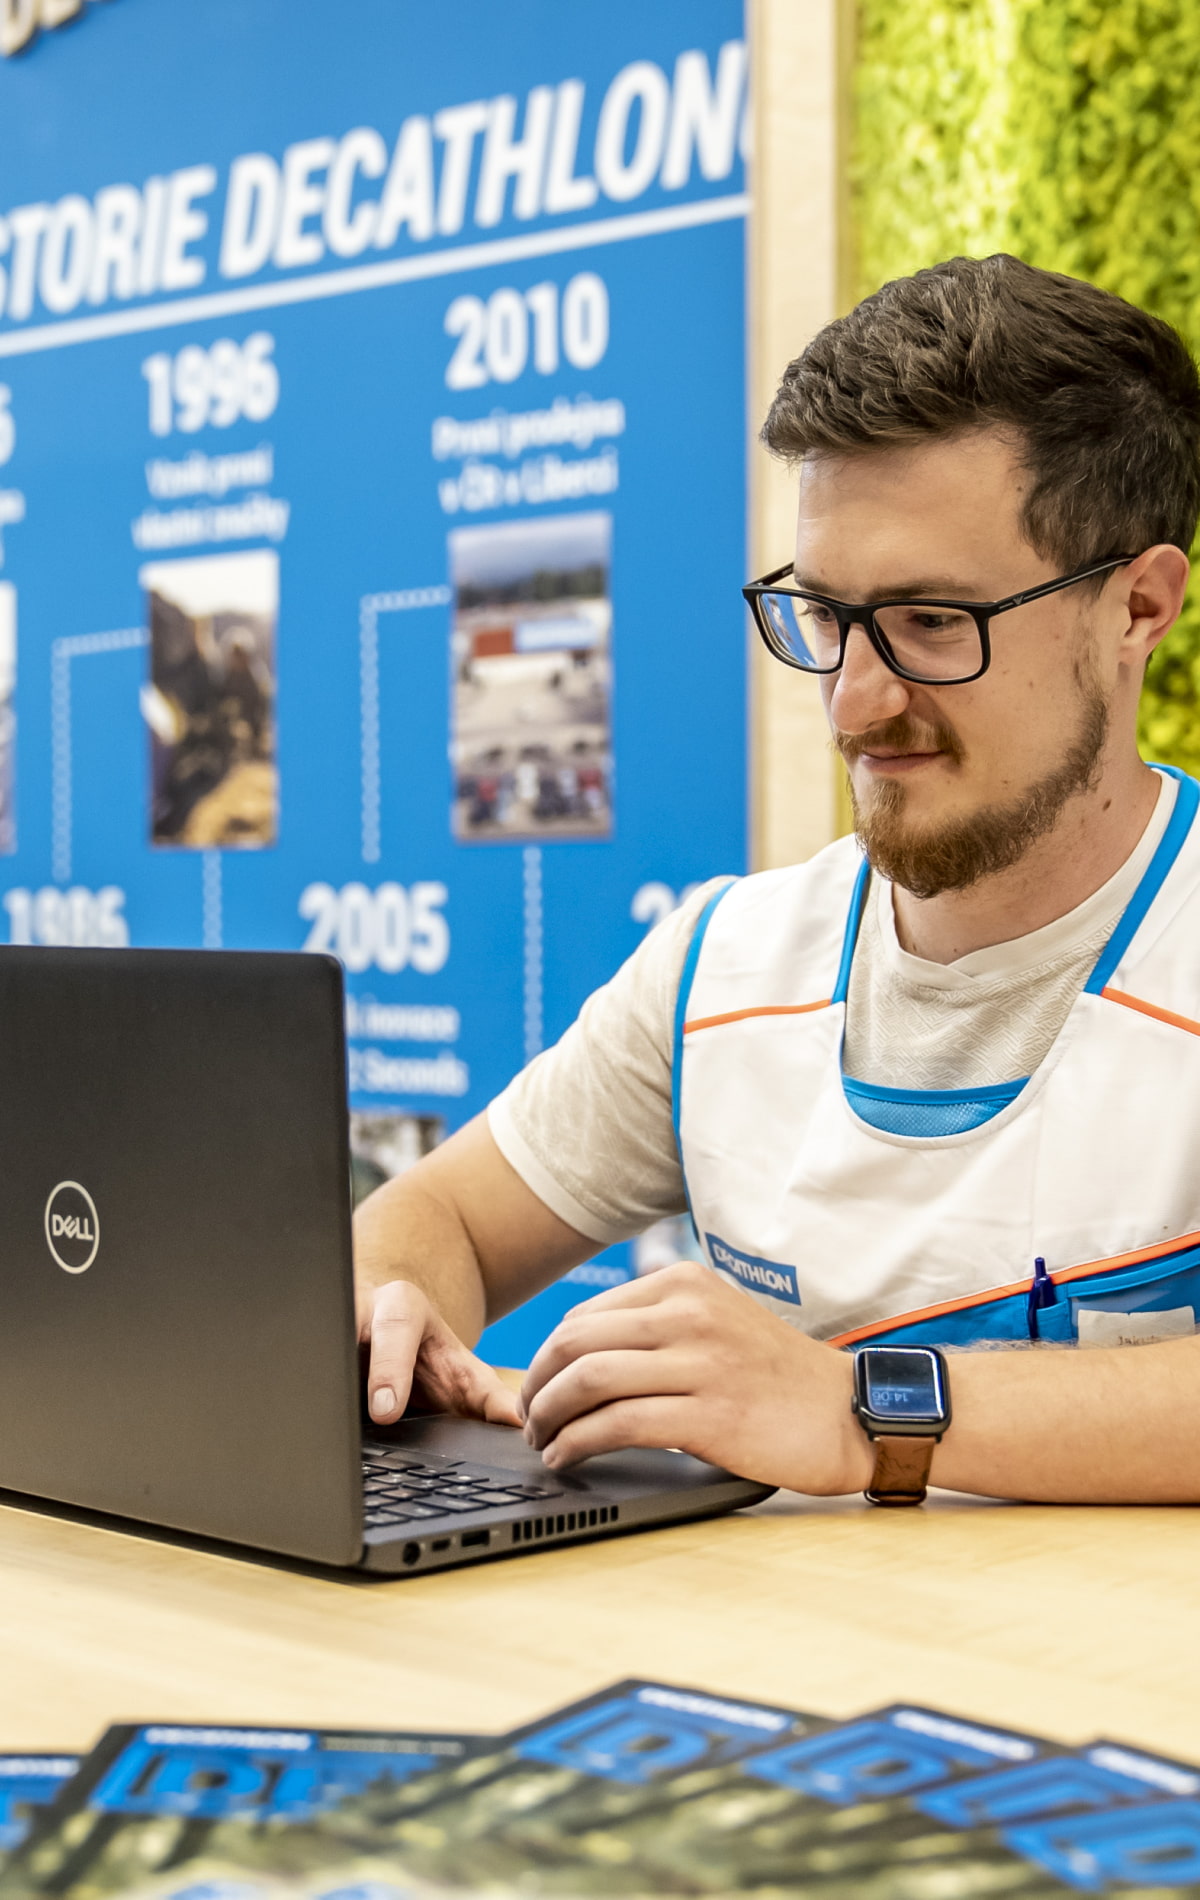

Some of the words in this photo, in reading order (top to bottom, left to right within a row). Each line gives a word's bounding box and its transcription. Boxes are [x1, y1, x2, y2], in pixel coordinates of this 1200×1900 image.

[0, 167, 217, 322] TORIE
[219, 39, 754, 279] DECATHLON
[141, 331, 280, 438] 1996
[444, 271, 609, 391] 2010
[299, 881, 450, 974] 2005
[52, 1214, 94, 1241] DELL
